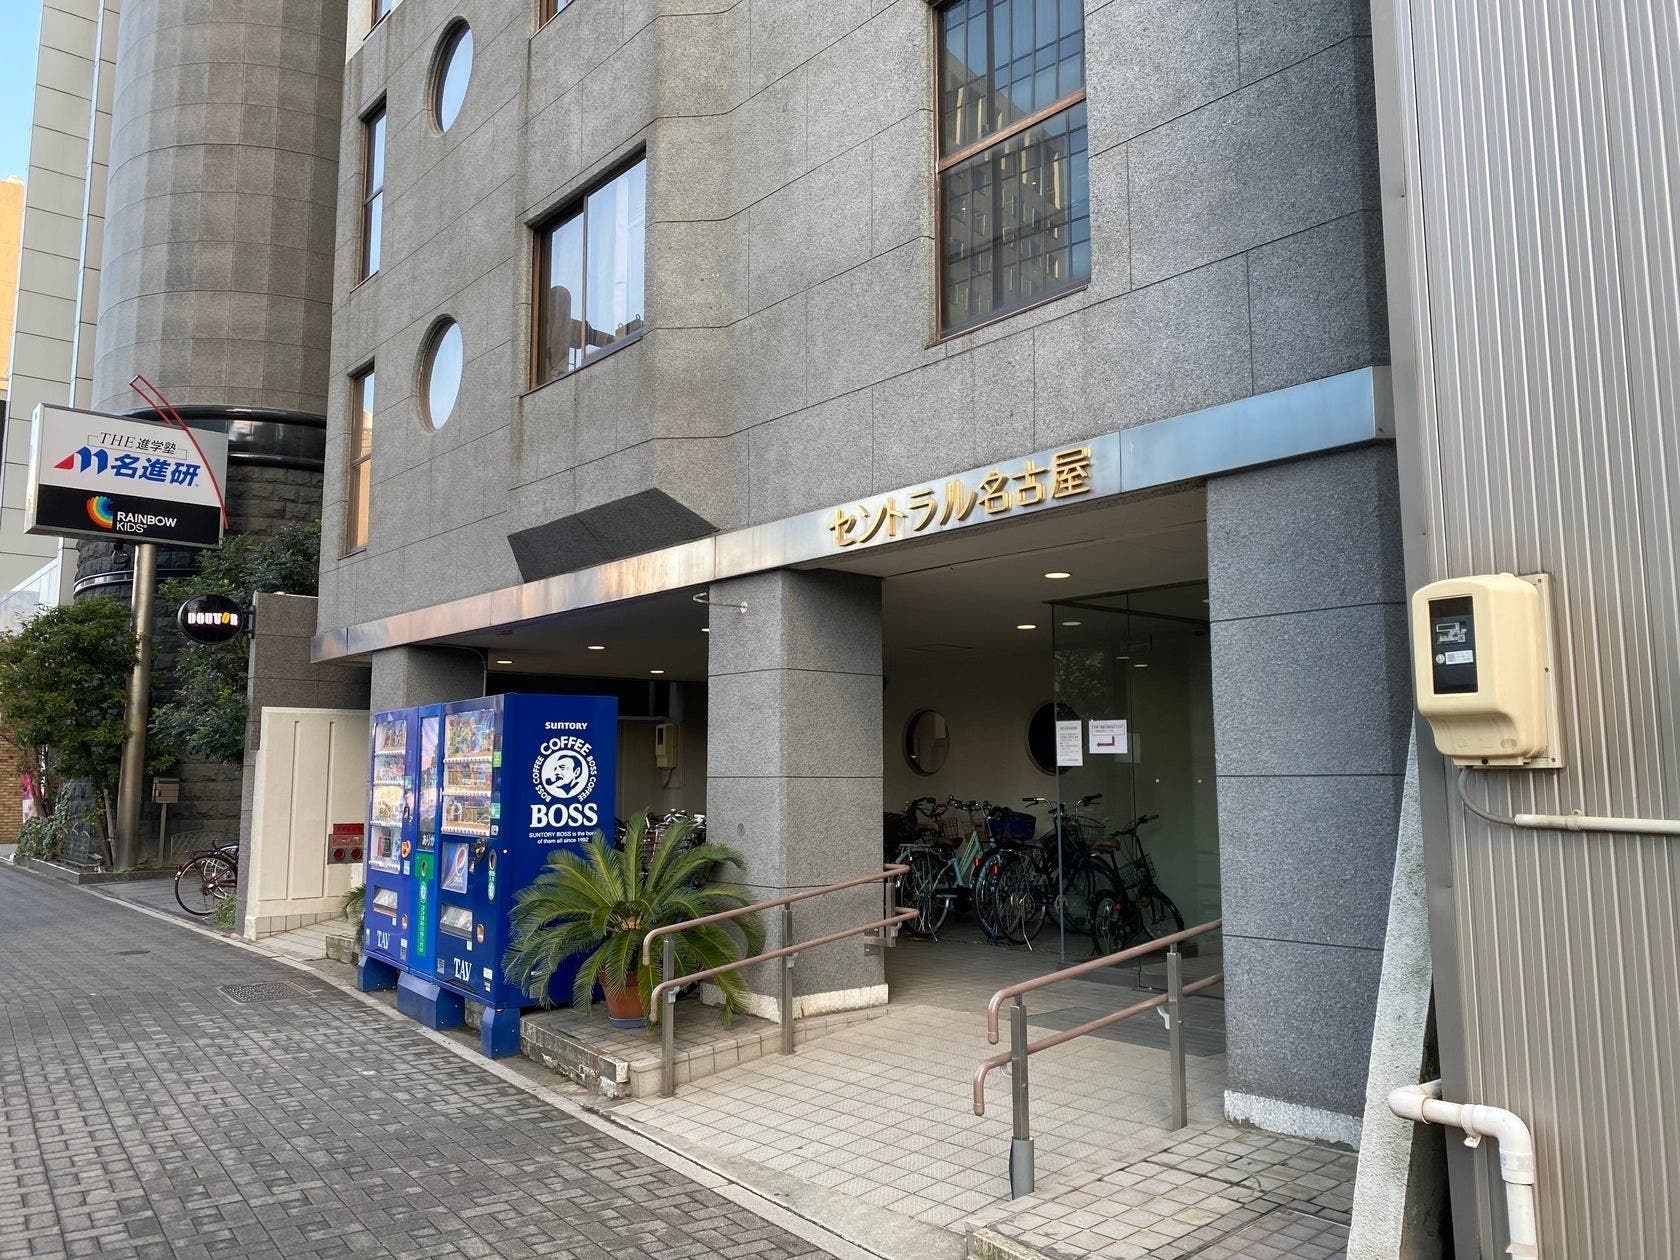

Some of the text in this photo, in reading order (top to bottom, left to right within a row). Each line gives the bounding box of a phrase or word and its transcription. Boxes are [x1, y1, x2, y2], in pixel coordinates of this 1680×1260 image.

[100, 432, 177, 455] THE 進学塾
[110, 453, 201, 487] 名進研
[828, 445, 1092, 547] セントラル名古屋
[117, 511, 177, 528] RAINBOW
[187, 612, 238, 626] DOUTOR
[544, 721, 588, 730] SUNTORY
[540, 735, 592, 756] COFFEE
[529, 802, 598, 828] BOSS
